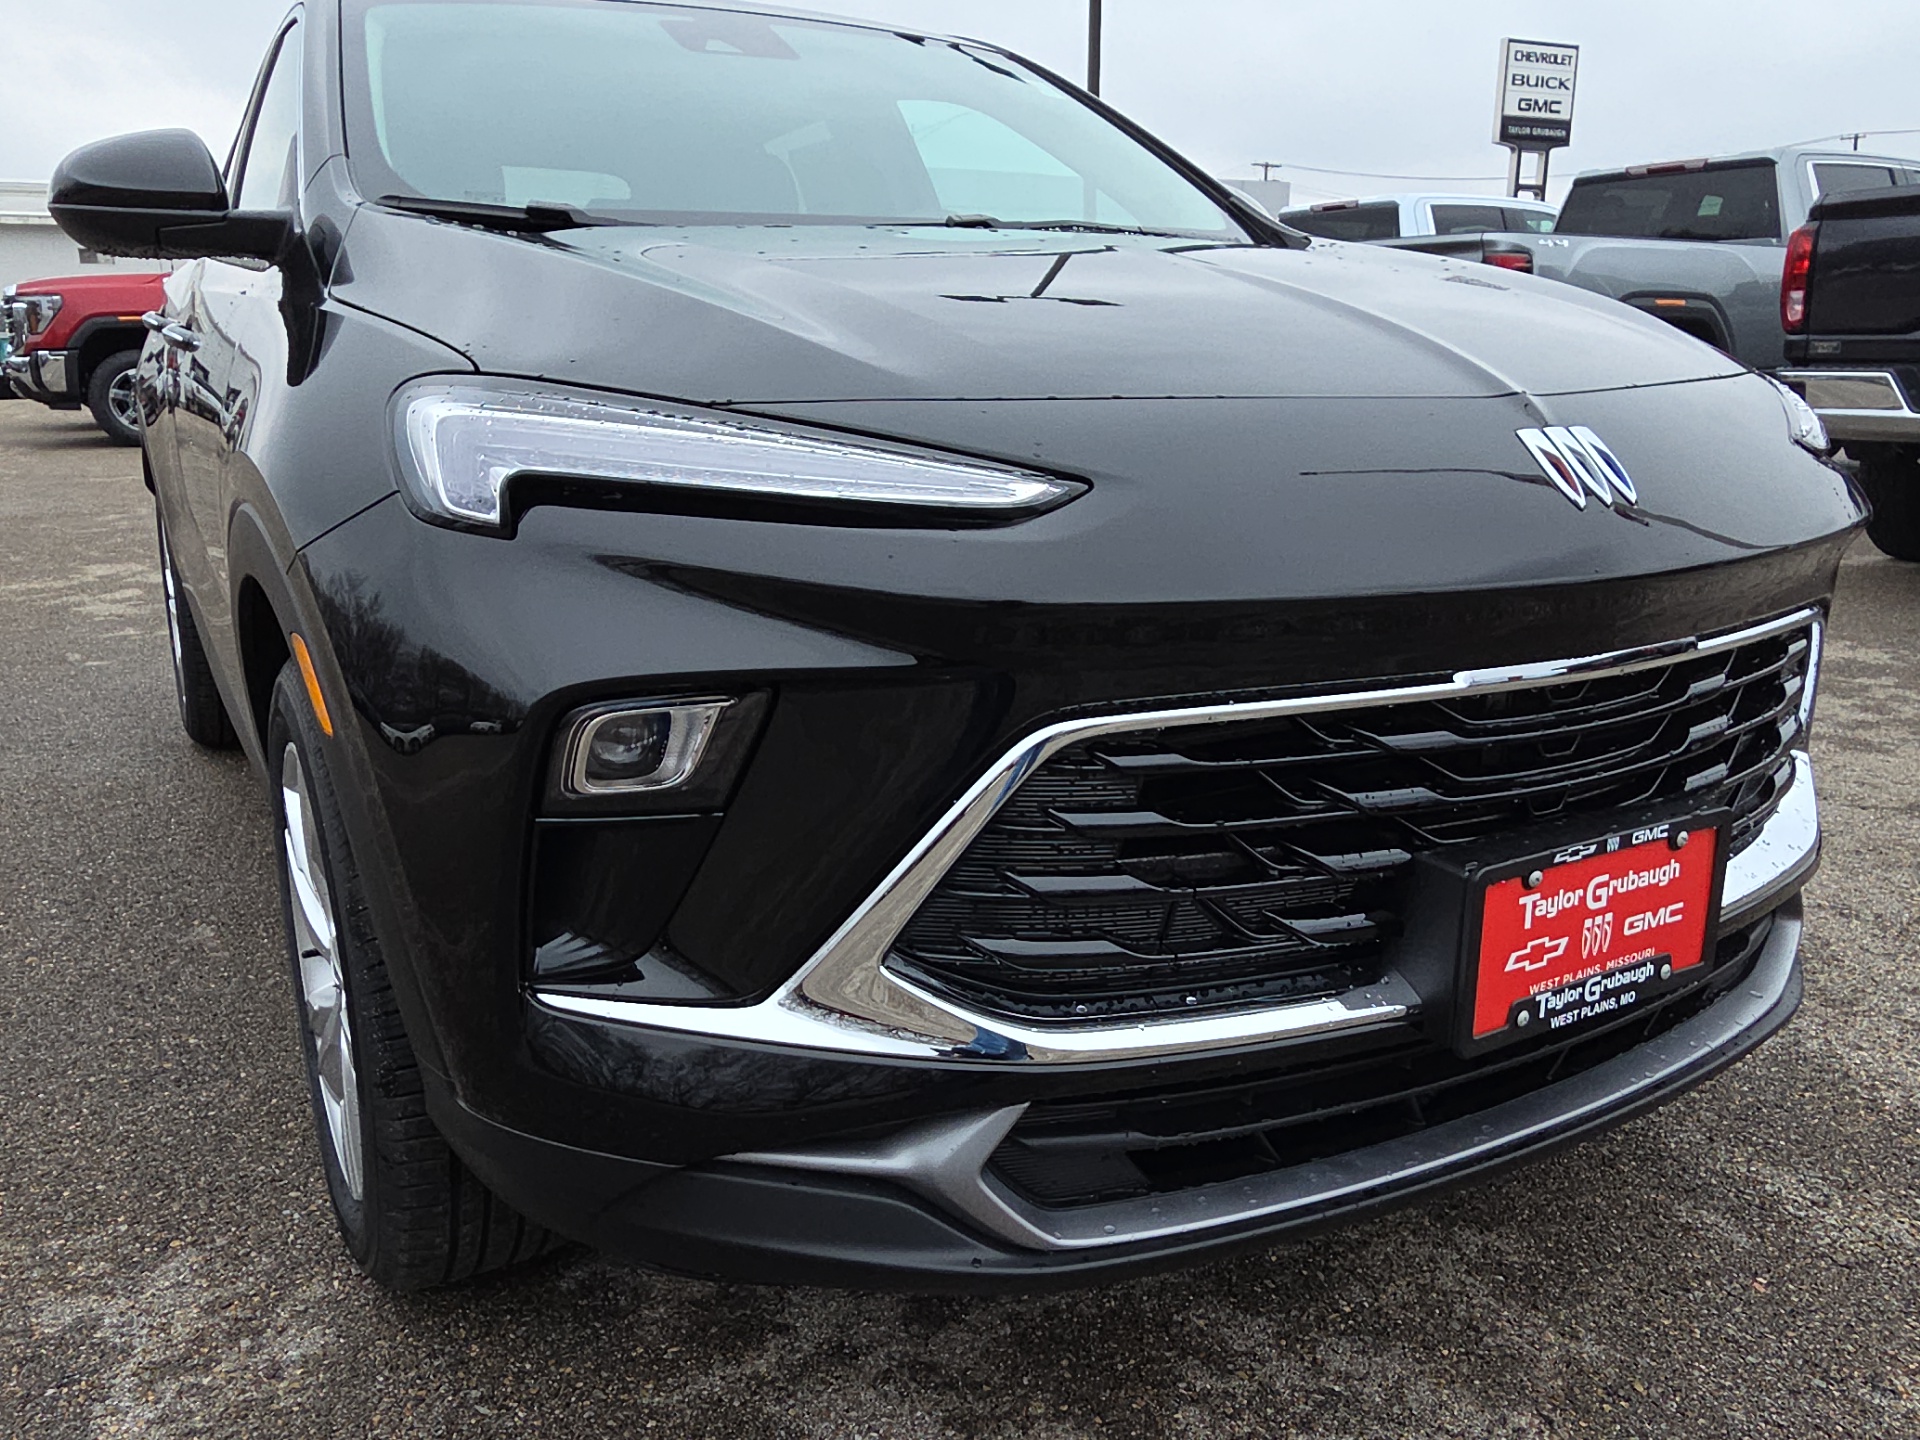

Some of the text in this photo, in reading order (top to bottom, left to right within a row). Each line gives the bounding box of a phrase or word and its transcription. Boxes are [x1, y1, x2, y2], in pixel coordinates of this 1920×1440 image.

[1514, 50, 1573, 66] CHEVROLET
[1511, 73, 1571, 91] BUICK
[1517, 97, 1562, 114] GMC
[1508, 125, 1530, 135] TAYLOR
[1631, 824, 1669, 845] GMC
[1519, 859, 1680, 930] Taylor Grubaugh
[1623, 902, 1684, 936] GMC
[1529, 976, 1561, 995] WEST
[1606, 946, 1656, 970] MISSOURI
[1535, 961, 1654, 1019] Taylor Grubaugh
[1550, 990, 1636, 1029] WEST PLAINS, MO
